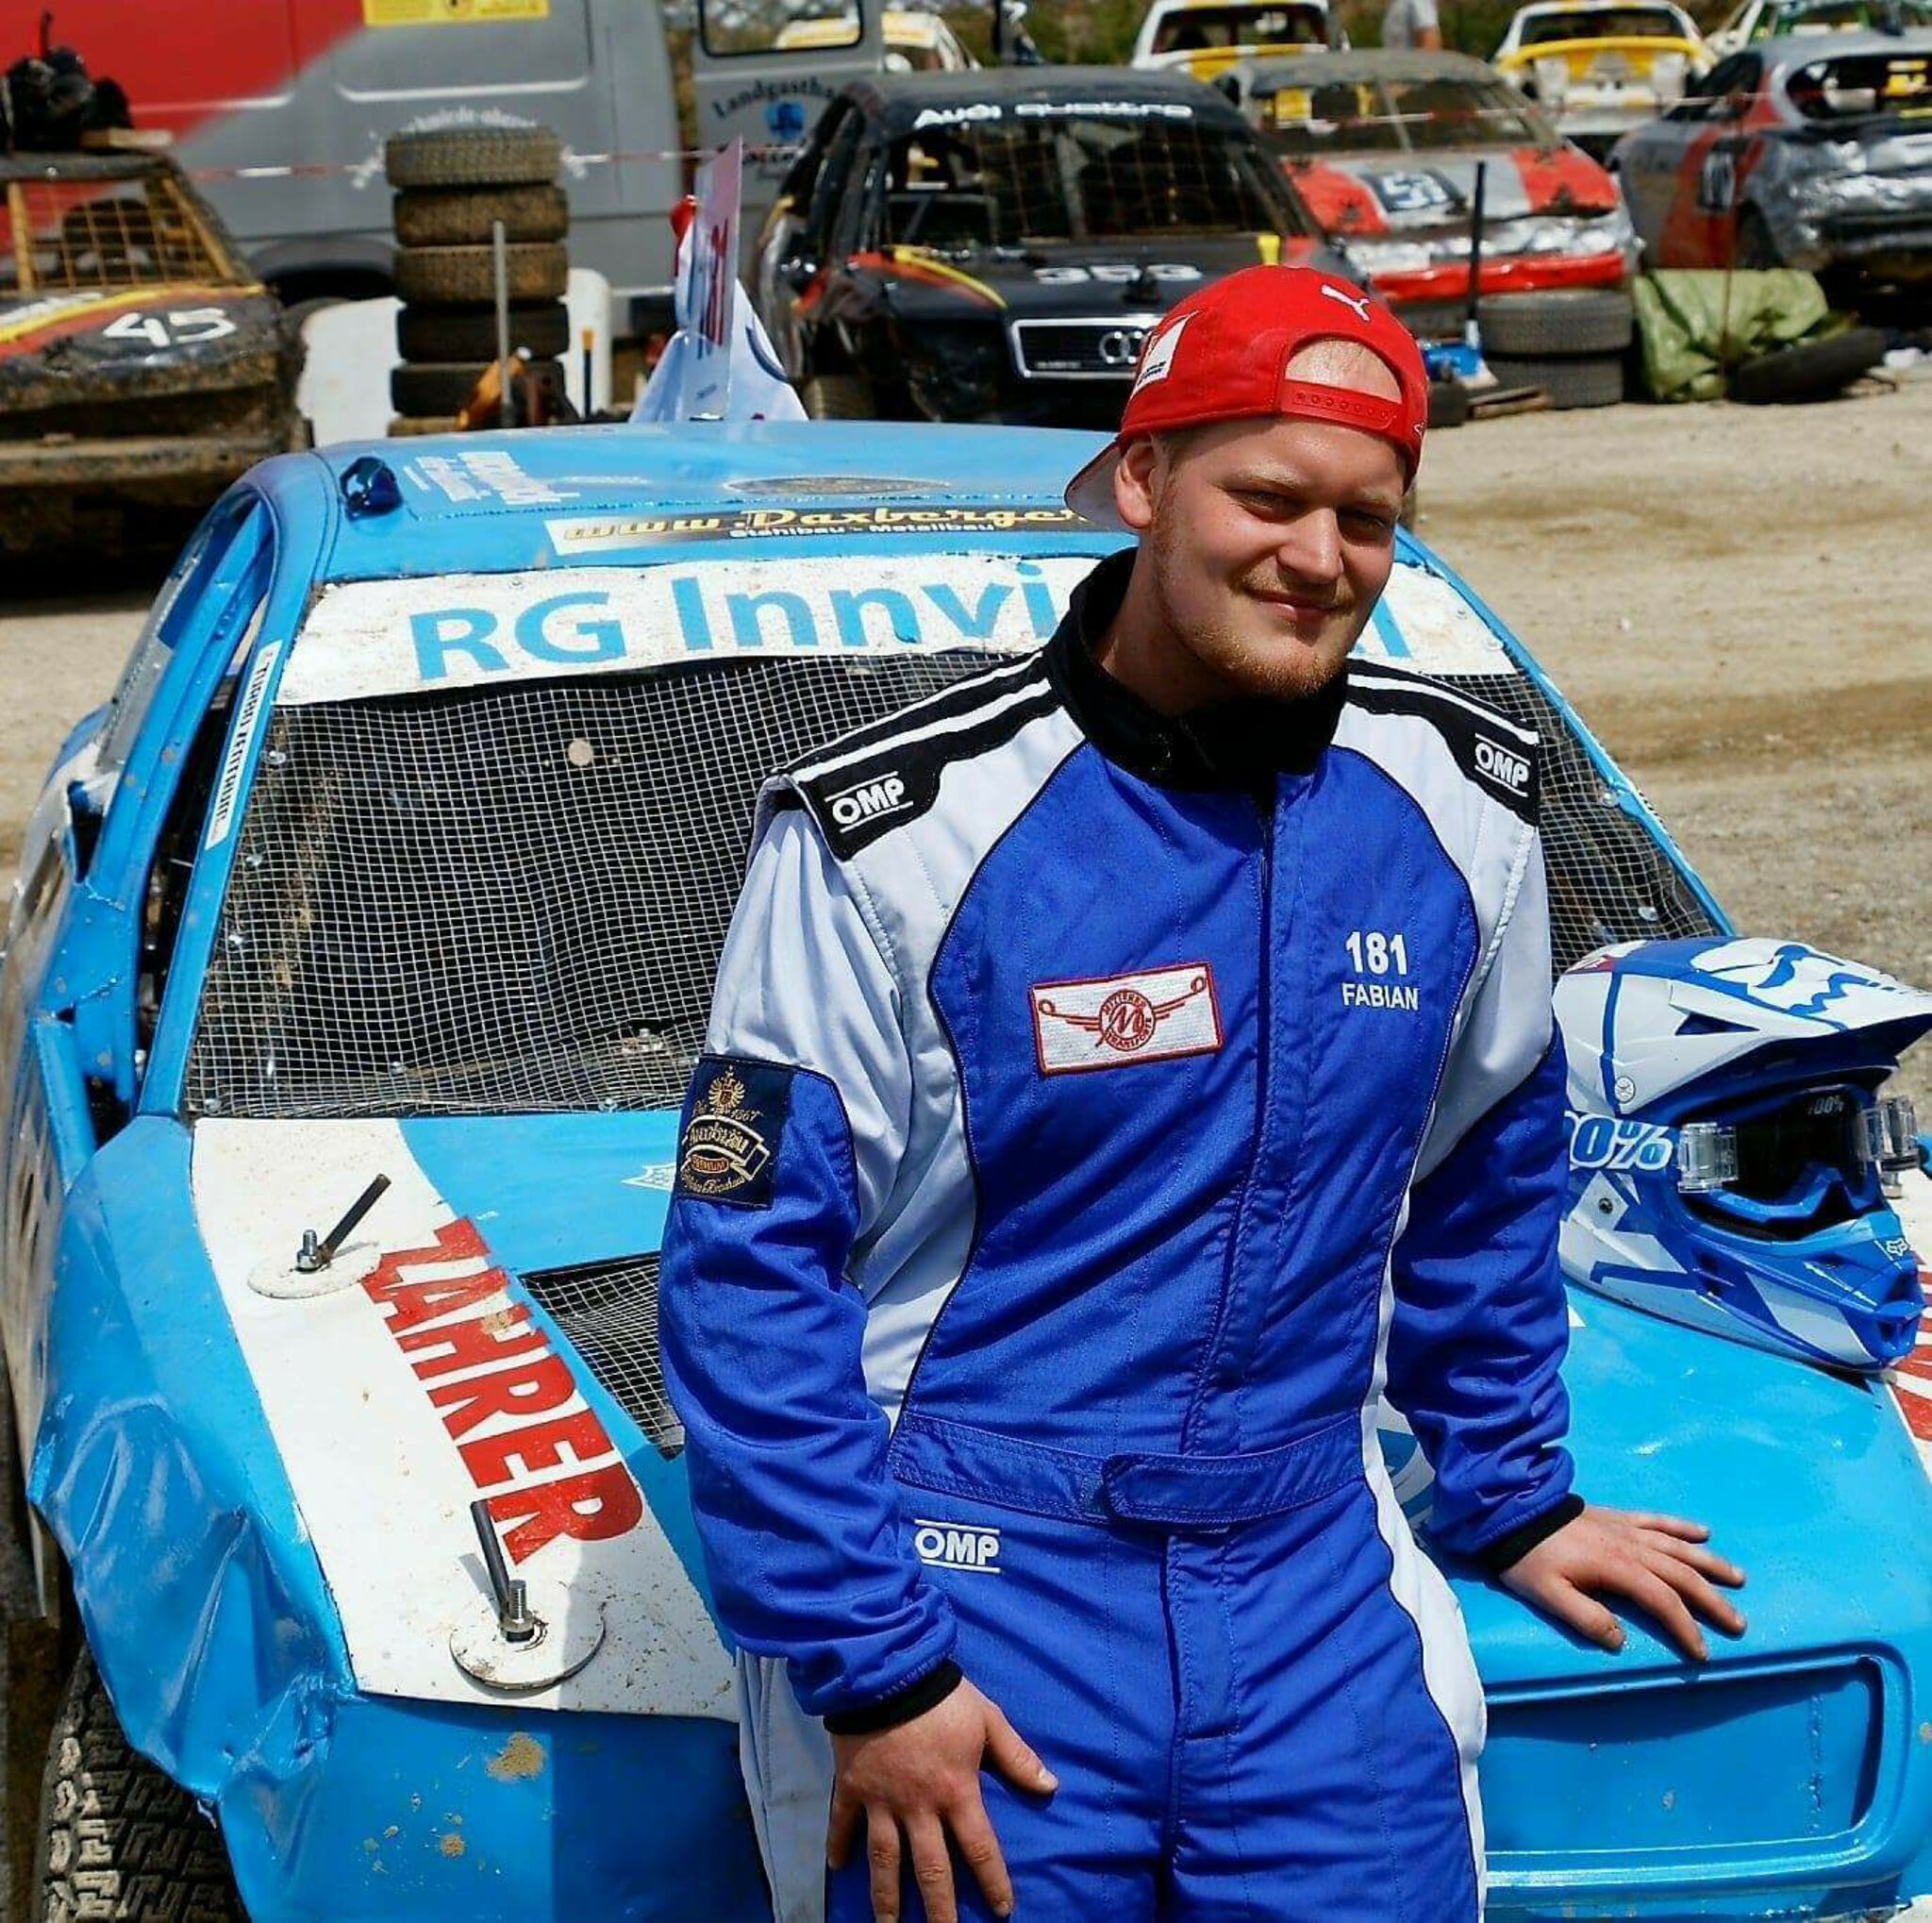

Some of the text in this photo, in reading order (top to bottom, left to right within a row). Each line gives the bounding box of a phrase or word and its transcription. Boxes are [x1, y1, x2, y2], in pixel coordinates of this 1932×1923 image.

[913, 102, 1002, 129] Audi
[102, 307, 237, 347] 45
[728, 525, 845, 539] Stahlbau
[869, 522, 995, 534] Metallbau
[408, 591, 630, 681] RG
[1474, 742, 1530, 788] OMP
[831, 777, 906, 825] OMP
[1344, 930, 1408, 976] 181
[1341, 981, 1420, 1012] FABIAN
[360, 1216, 644, 1566] ZAHRER
[913, 1527, 1000, 1566] OMP
